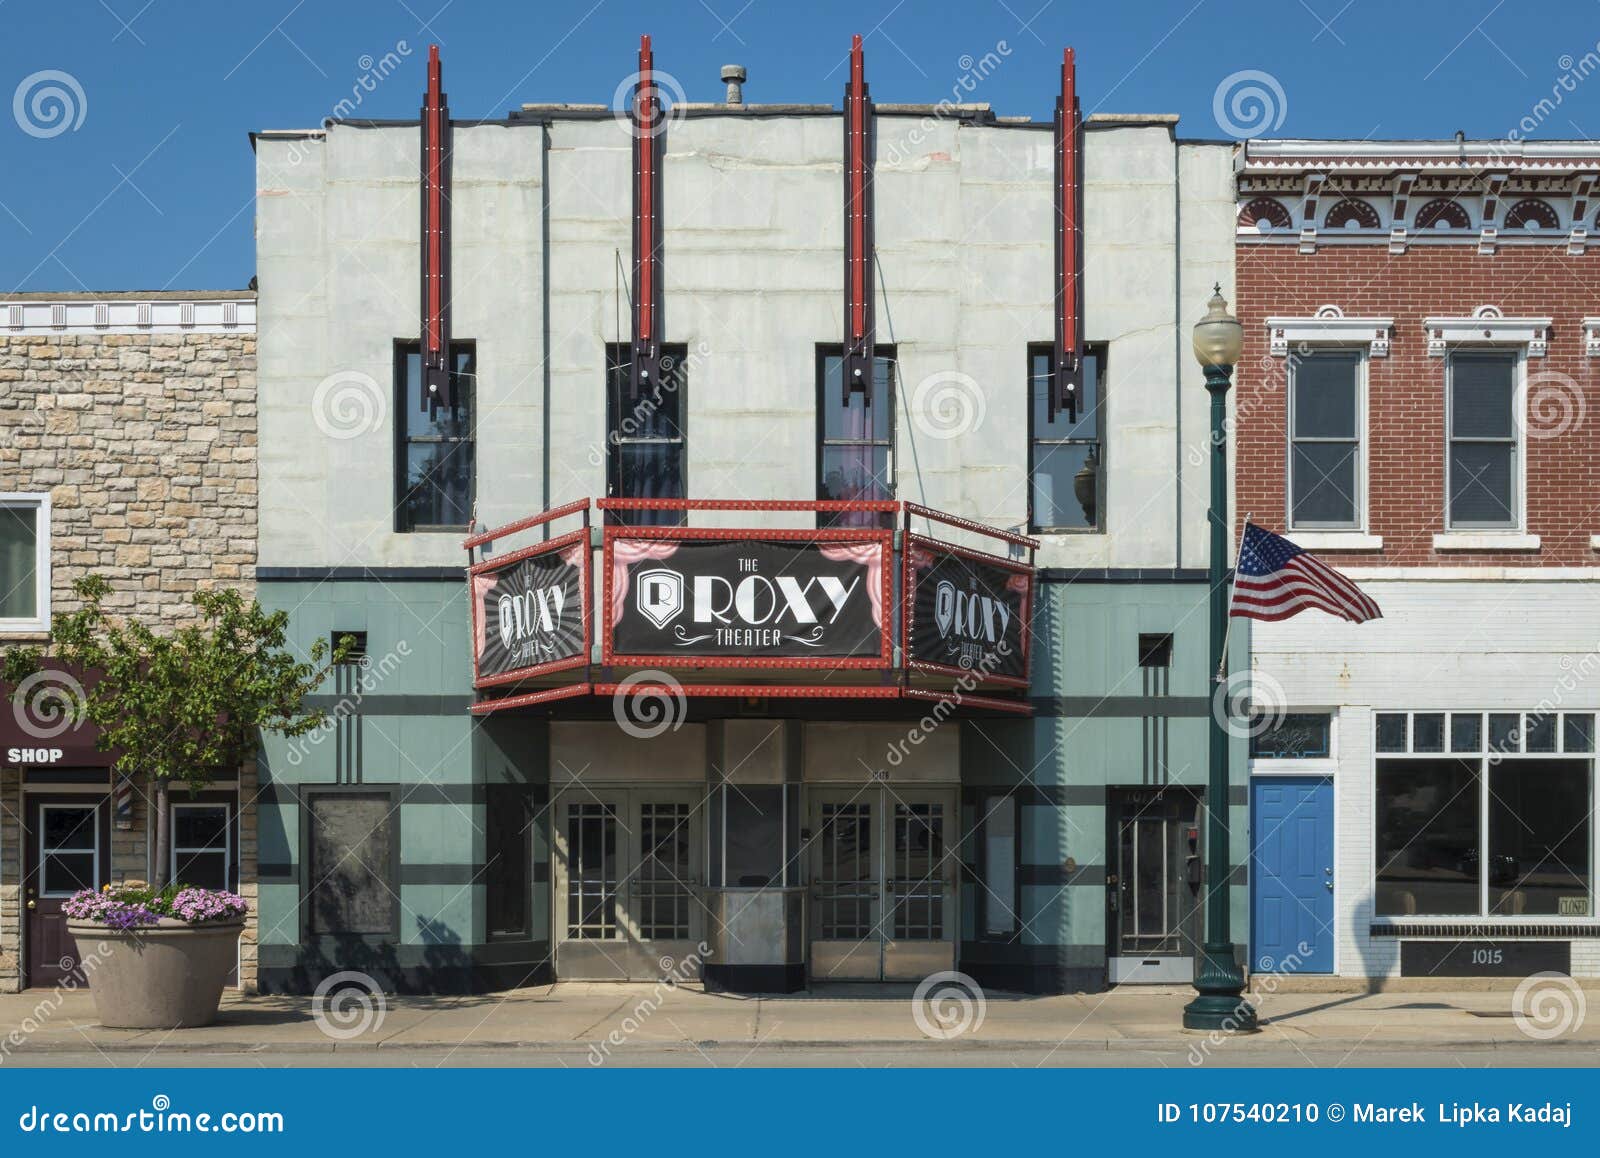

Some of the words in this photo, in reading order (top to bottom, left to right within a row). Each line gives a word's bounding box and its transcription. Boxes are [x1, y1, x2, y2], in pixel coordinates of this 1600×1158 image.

[738, 558, 758, 572] THE
[694, 574, 860, 625] ROXY
[513, 582, 567, 640] ROXY
[954, 590, 1010, 642] ROXY
[715, 628, 782, 646] THEATER
[8, 748, 63, 763] SHOP
[1472, 949, 1503, 964] 1015
